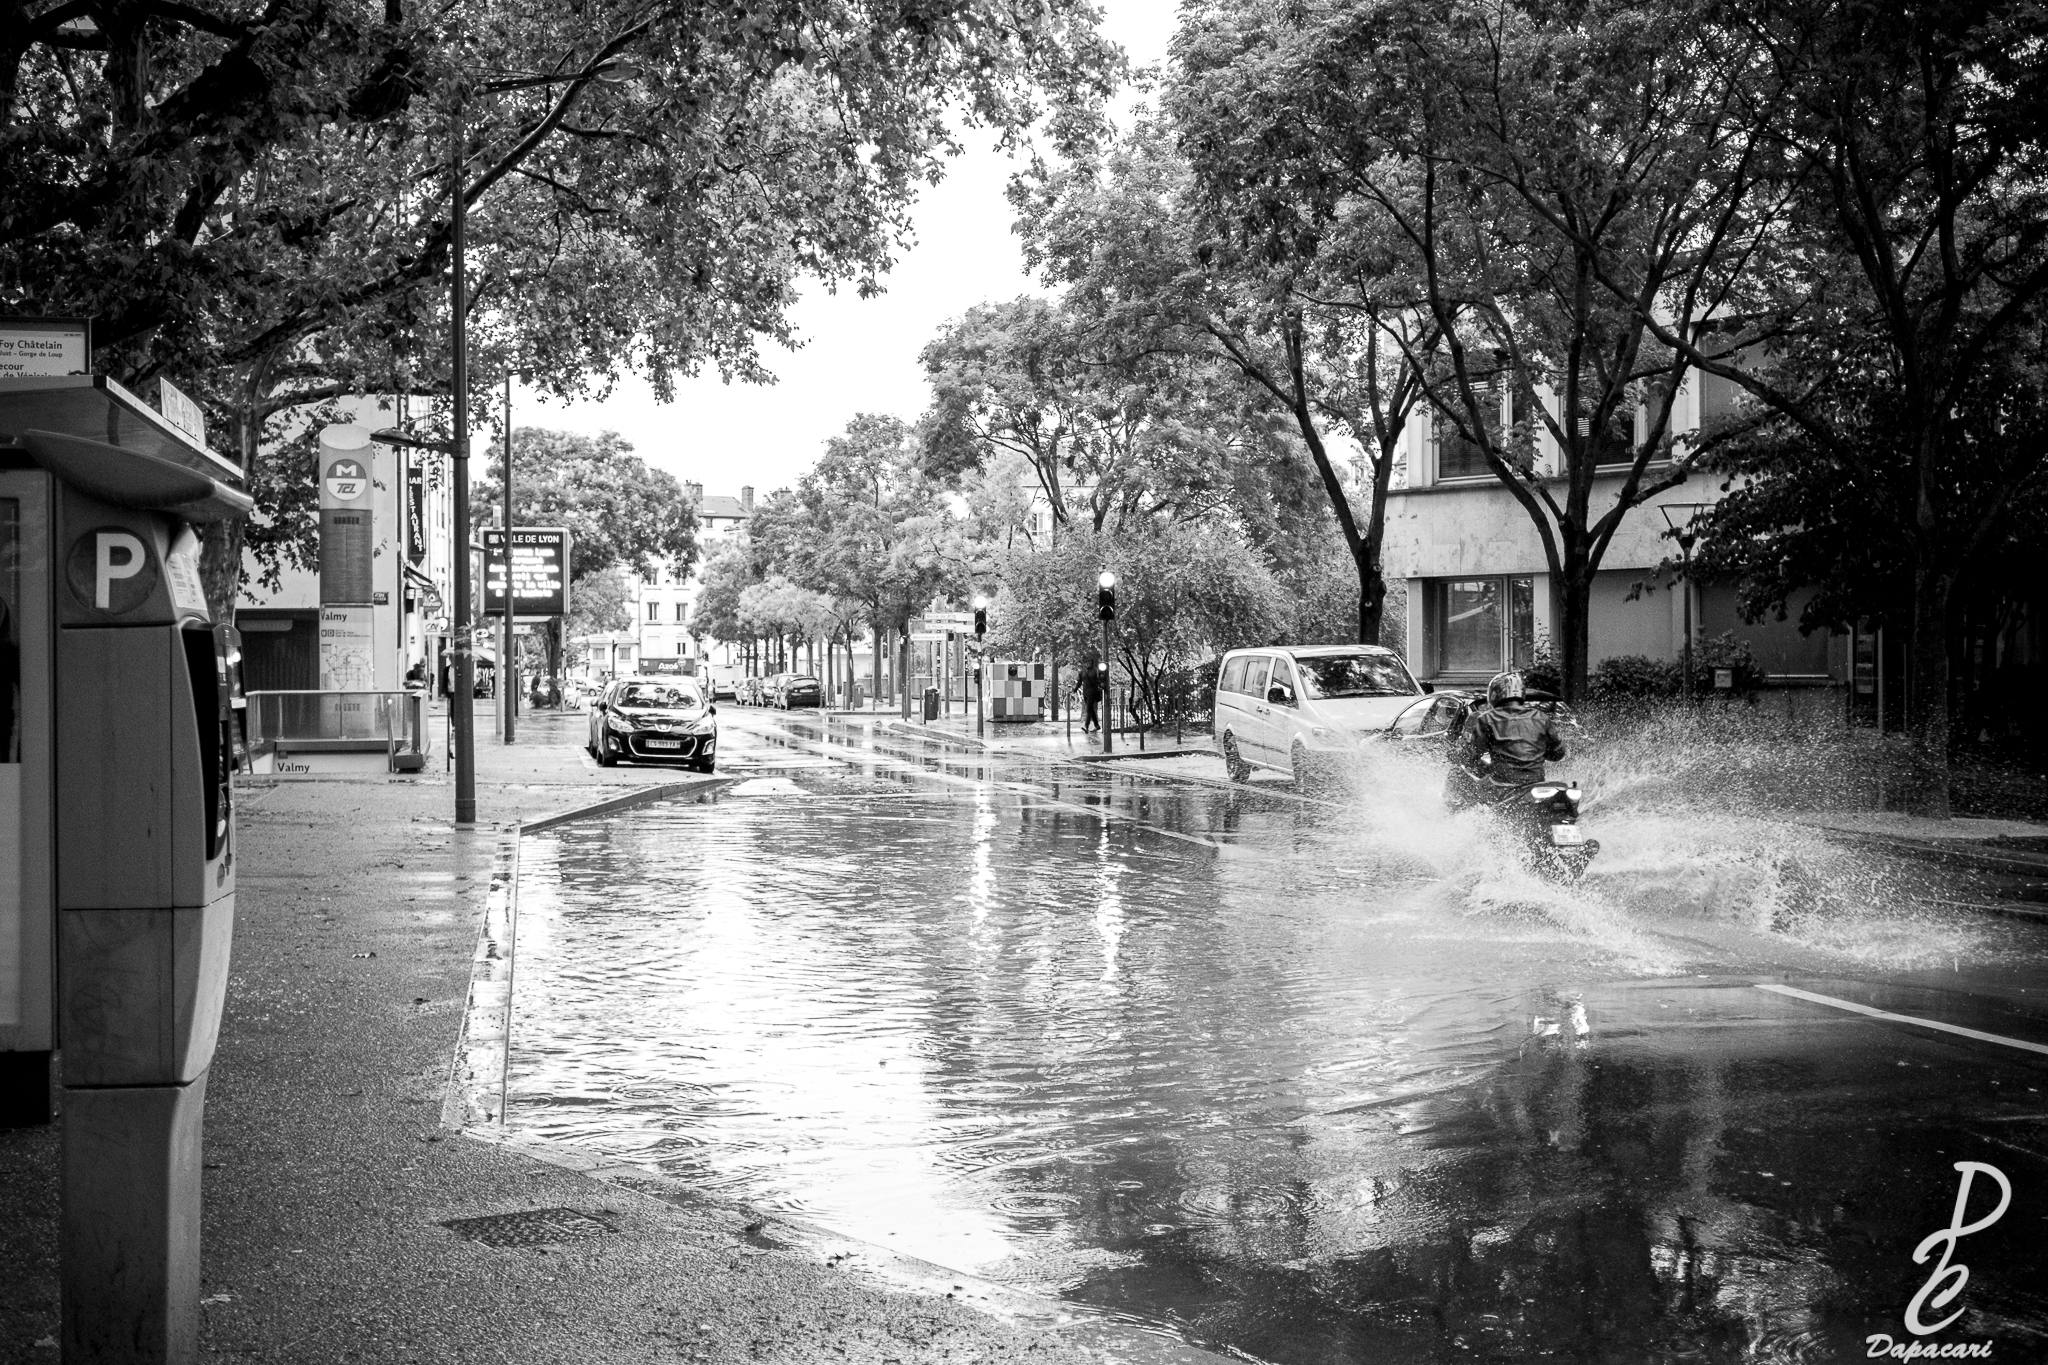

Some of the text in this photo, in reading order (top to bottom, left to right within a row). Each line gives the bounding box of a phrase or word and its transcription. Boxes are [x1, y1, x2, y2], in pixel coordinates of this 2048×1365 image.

[18, 340, 63, 349] Châtelain
[336, 465, 357, 477] M
[501, 535, 560, 543] VLE DE LYON
[95, 532, 146, 608] P
[321, 611, 347, 622] Valmy
[278, 763, 310, 774] Valmy
